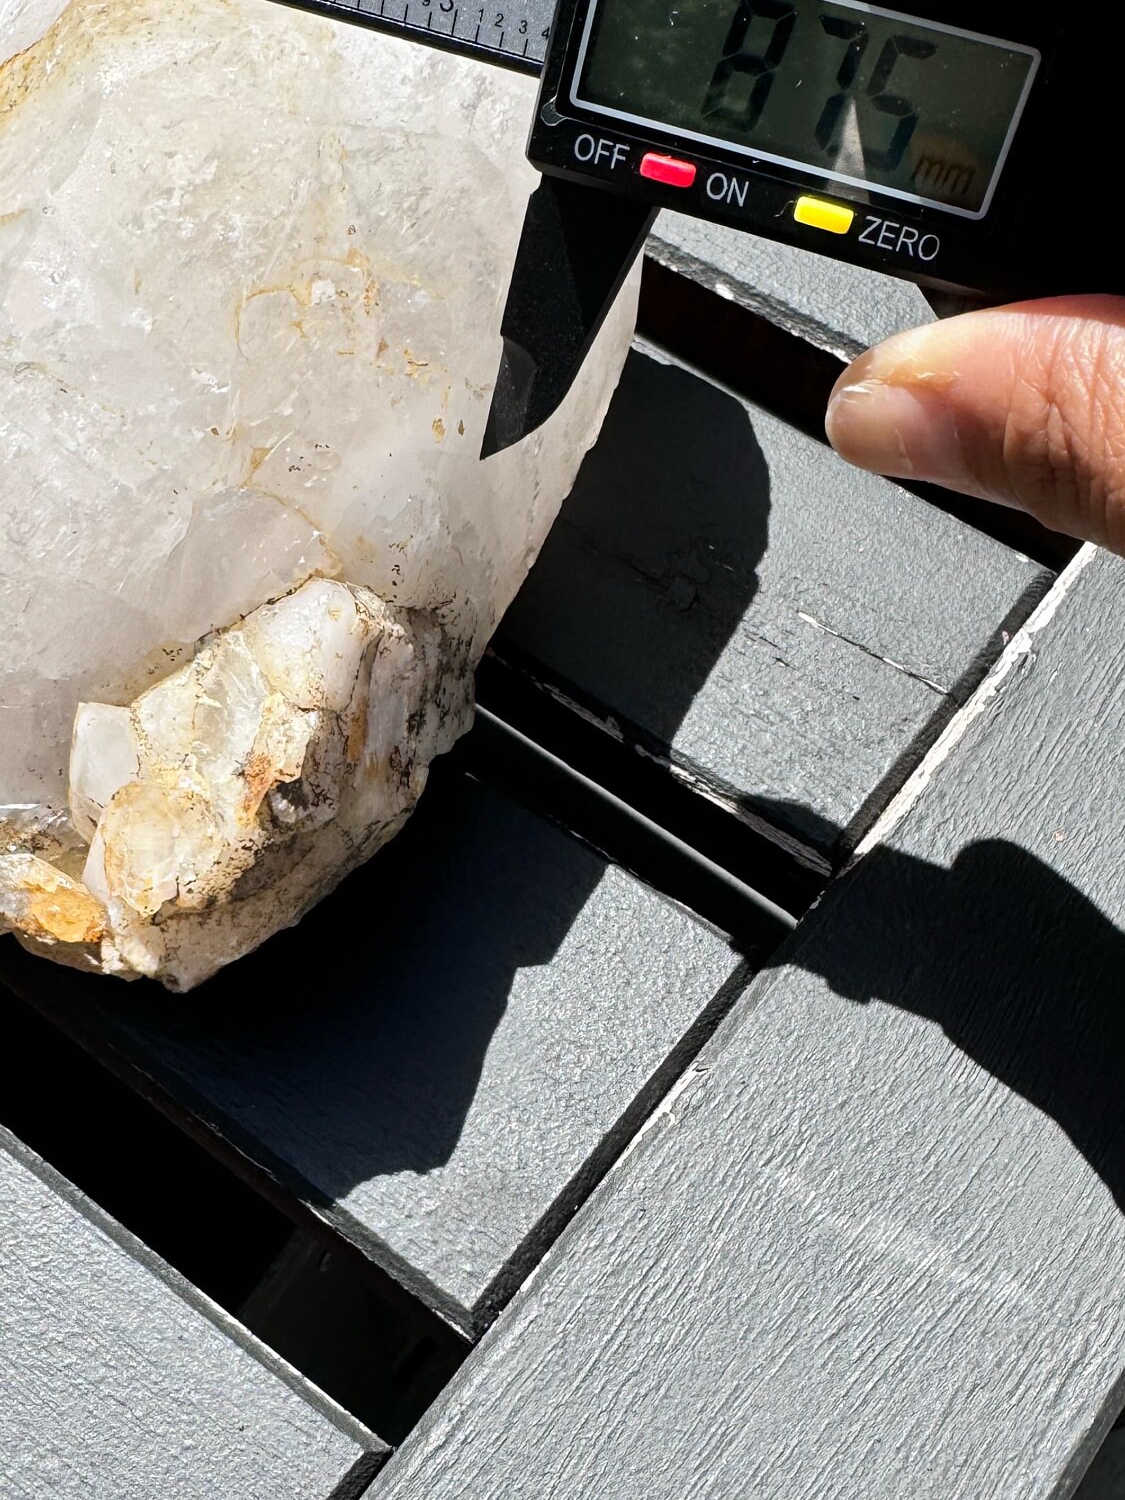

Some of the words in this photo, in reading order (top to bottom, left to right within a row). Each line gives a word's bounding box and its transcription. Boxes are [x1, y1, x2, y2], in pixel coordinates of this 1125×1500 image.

[478, 8, 484, 23] 1
[494, 13, 504, 28] 2
[518, 19, 528, 34] 3
[910, 155, 976, 196] mm
[575, 134, 629, 169] OFF
[707, 173, 749, 206] ON
[859, 216, 939, 260] ZERO
